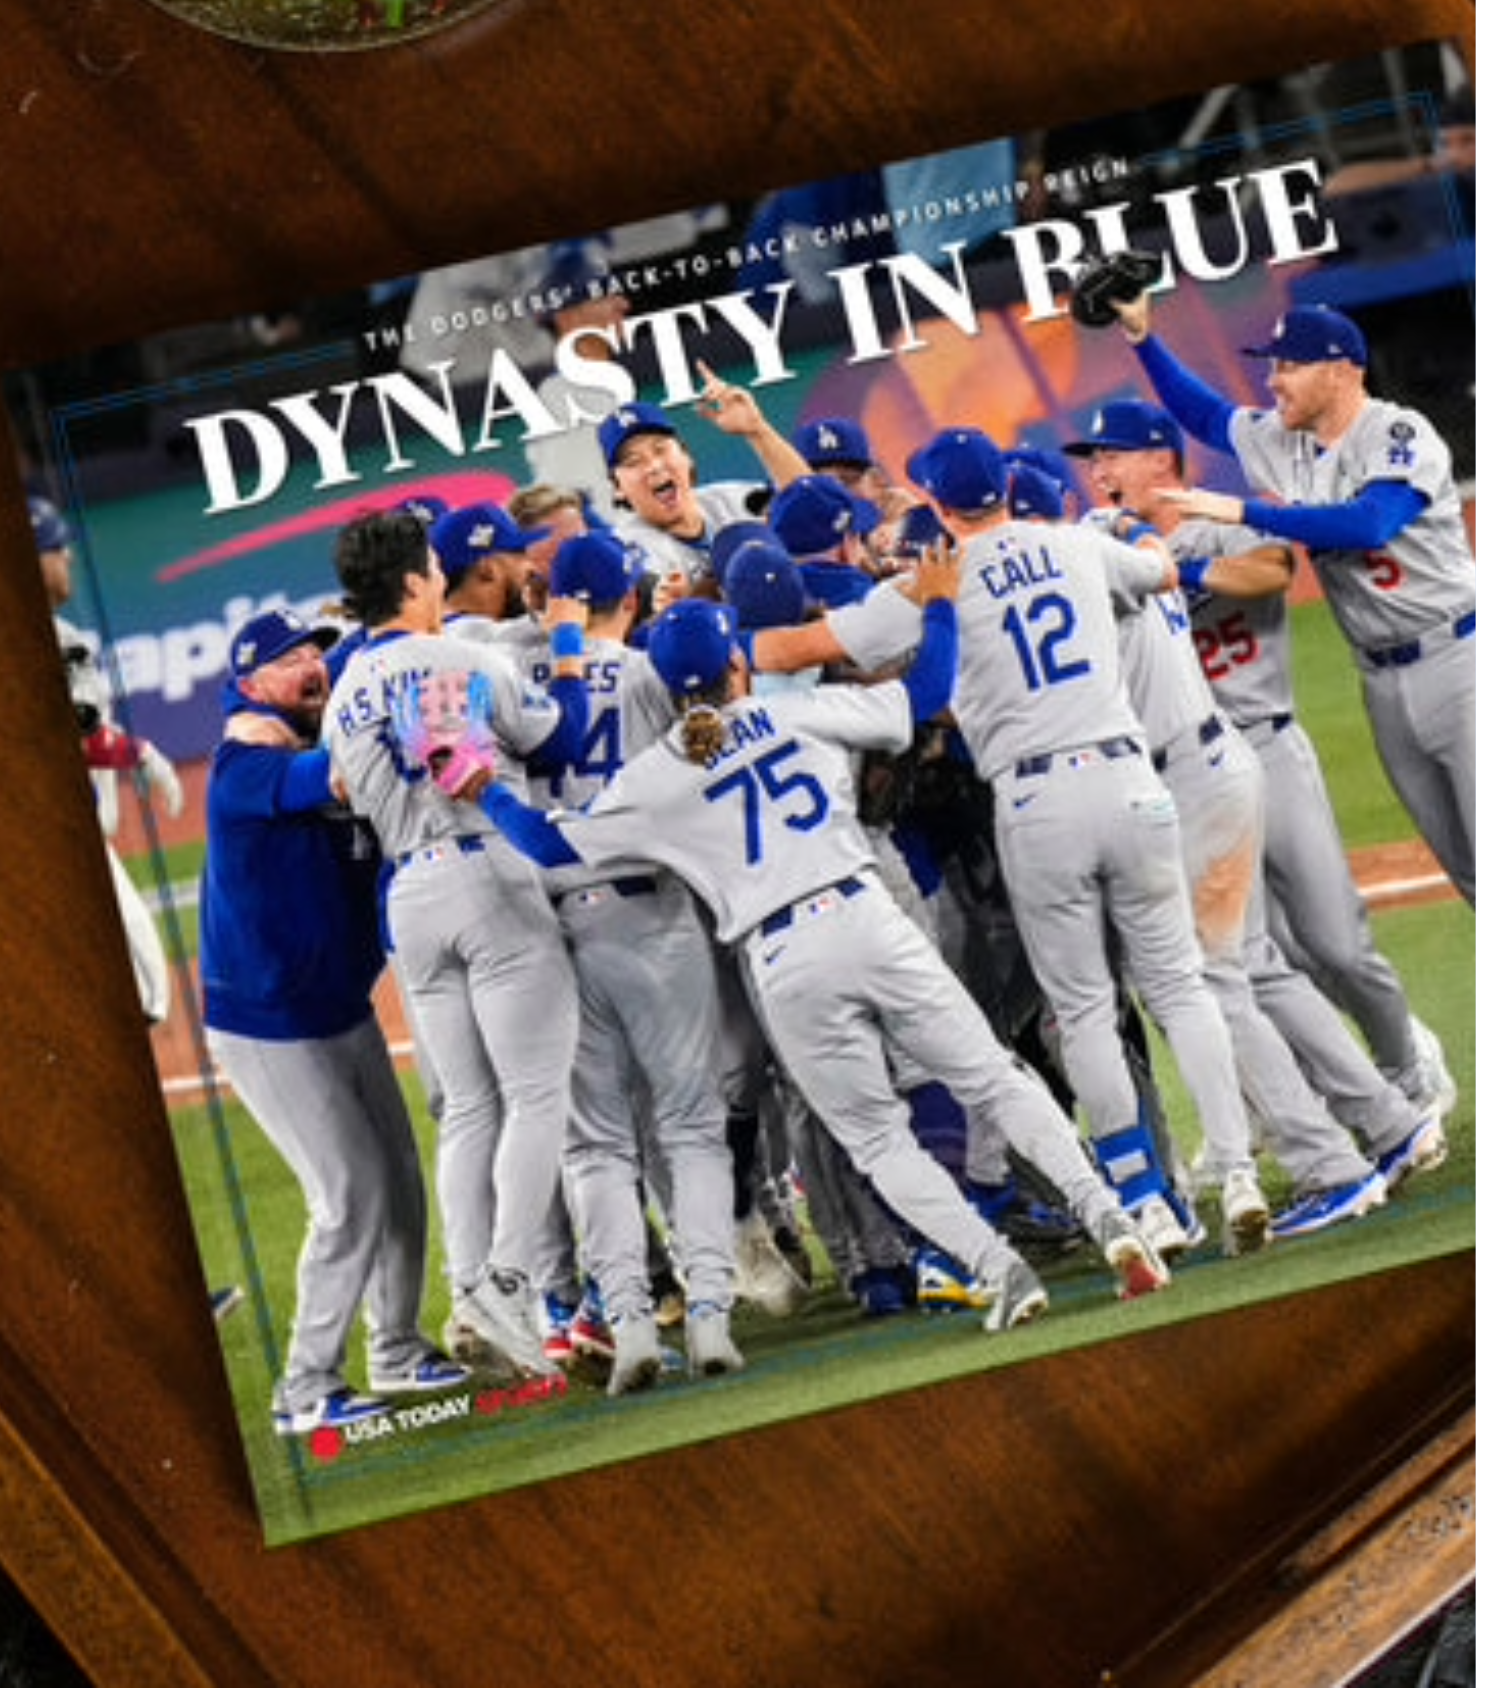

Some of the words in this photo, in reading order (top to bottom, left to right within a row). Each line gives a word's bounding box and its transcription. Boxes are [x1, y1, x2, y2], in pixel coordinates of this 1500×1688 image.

[364, 324, 416, 350] THE
[429, 285, 573, 335] DODGERS'
[588, 233, 799, 297] BACK-TO-BACK
[811, 181, 1030, 248] CHAMPIONSHIP
[1043, 157, 1130, 192] REIGN
[184, 281, 798, 516] DYNASTY
[826, 242, 981, 364] IN
[1002, 159, 1340, 326] BLUE
[979, 544, 1063, 599] CALL
[1001, 590, 1091, 691] 12
[1193, 609, 1261, 682] 25
[703, 737, 830, 867] 75
[344, 1416, 395, 1444] USA
[394, 1394, 471, 1430] TODAY
